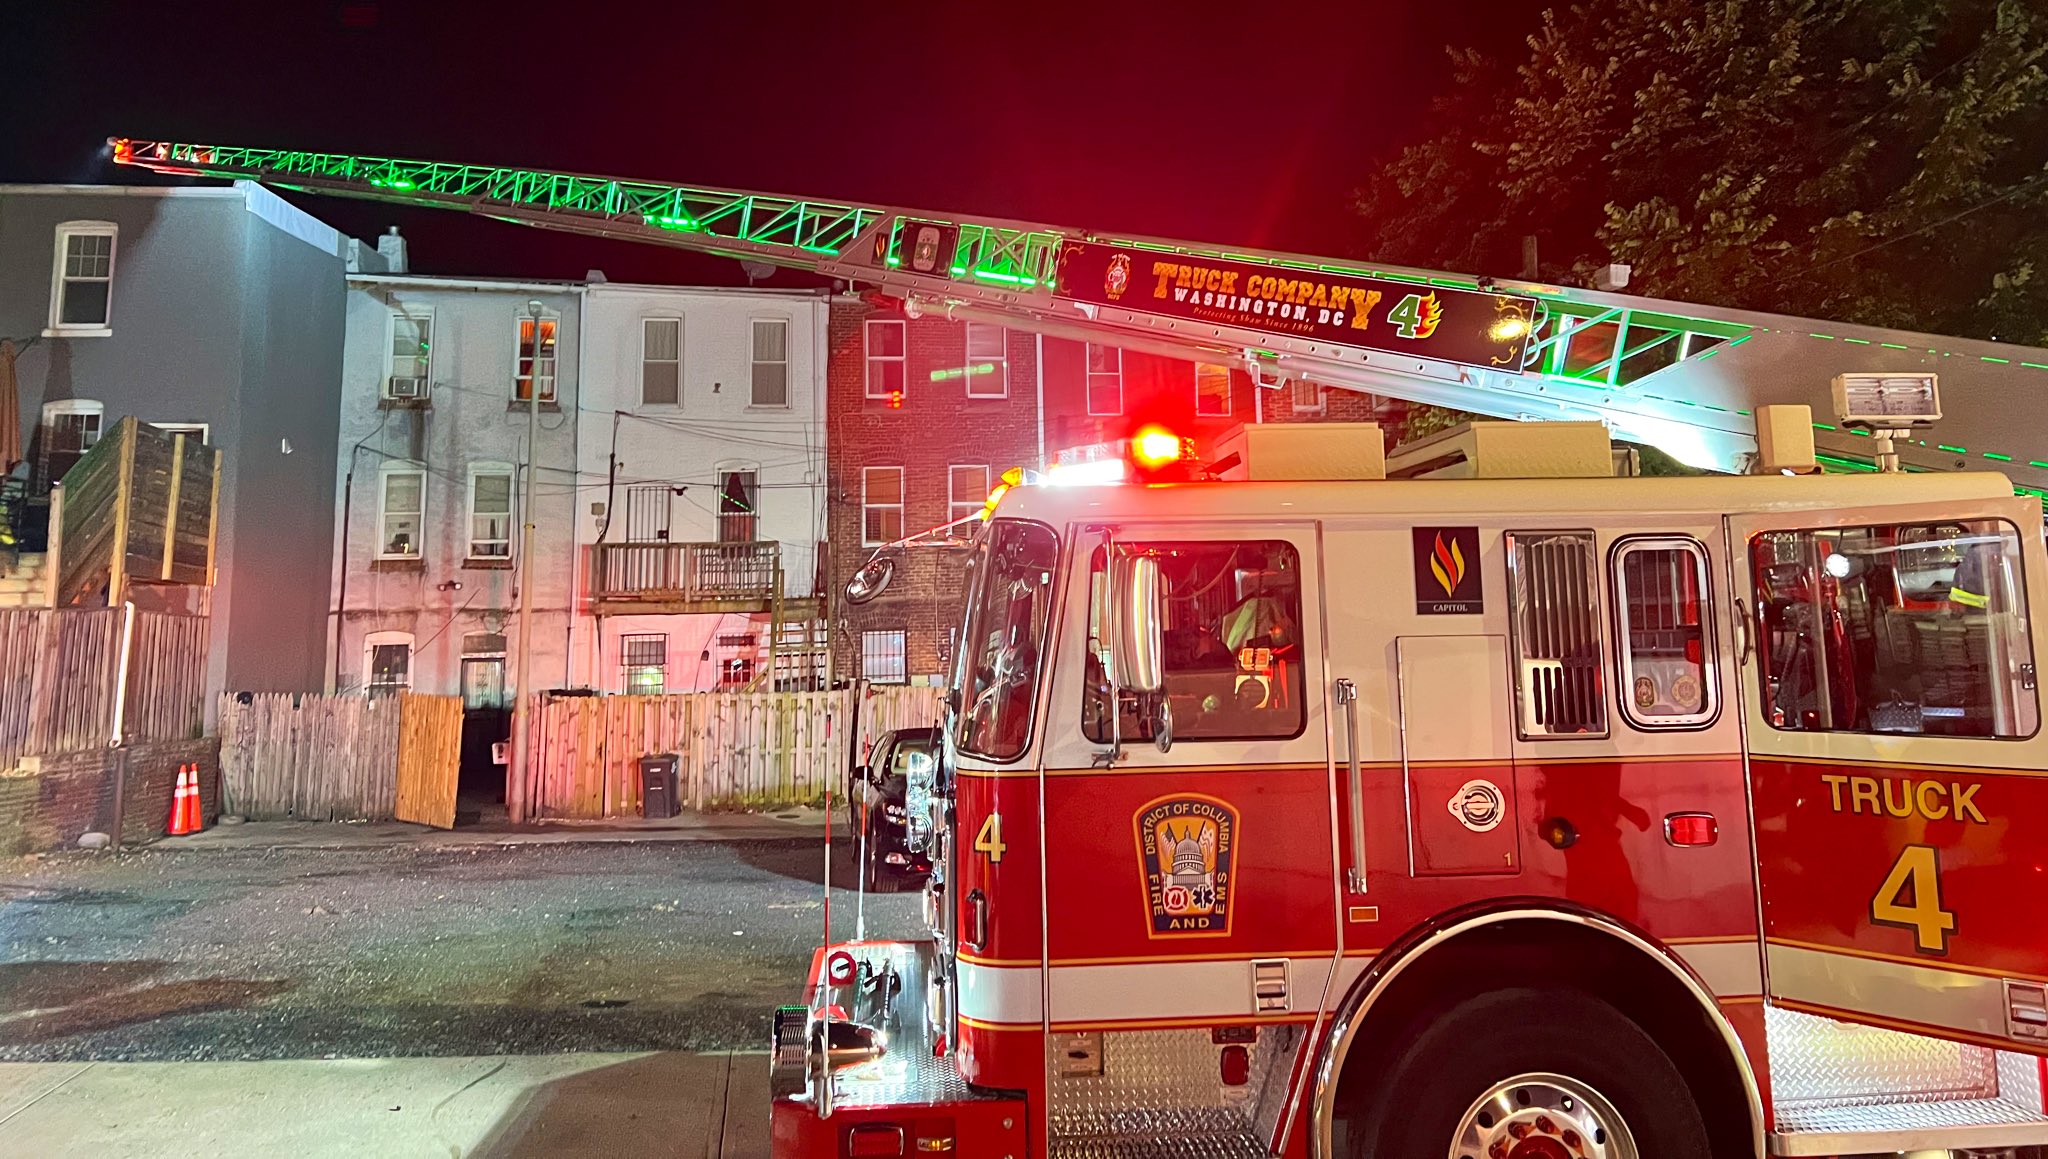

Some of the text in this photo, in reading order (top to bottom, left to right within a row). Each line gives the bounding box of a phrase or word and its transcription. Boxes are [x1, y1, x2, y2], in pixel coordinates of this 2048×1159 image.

[1152, 261, 1382, 330] TRUCK COMPANY
[1193, 306, 1315, 333] Protecting Shaw Since 1896
[1318, 309, 1345, 326] DC
[1386, 293, 1422, 339] 4
[1433, 604, 1468, 612] CAPITOL
[1821, 774, 1988, 824] TRUCK
[974, 814, 1006, 863] 4
[1143, 803, 1230, 855] DISTRICT OF COLUMBIA
[1504, 852, 1512, 867] 1
[1149, 872, 1227, 929] FIRE AND EMS
[1871, 843, 1956, 953] 4
